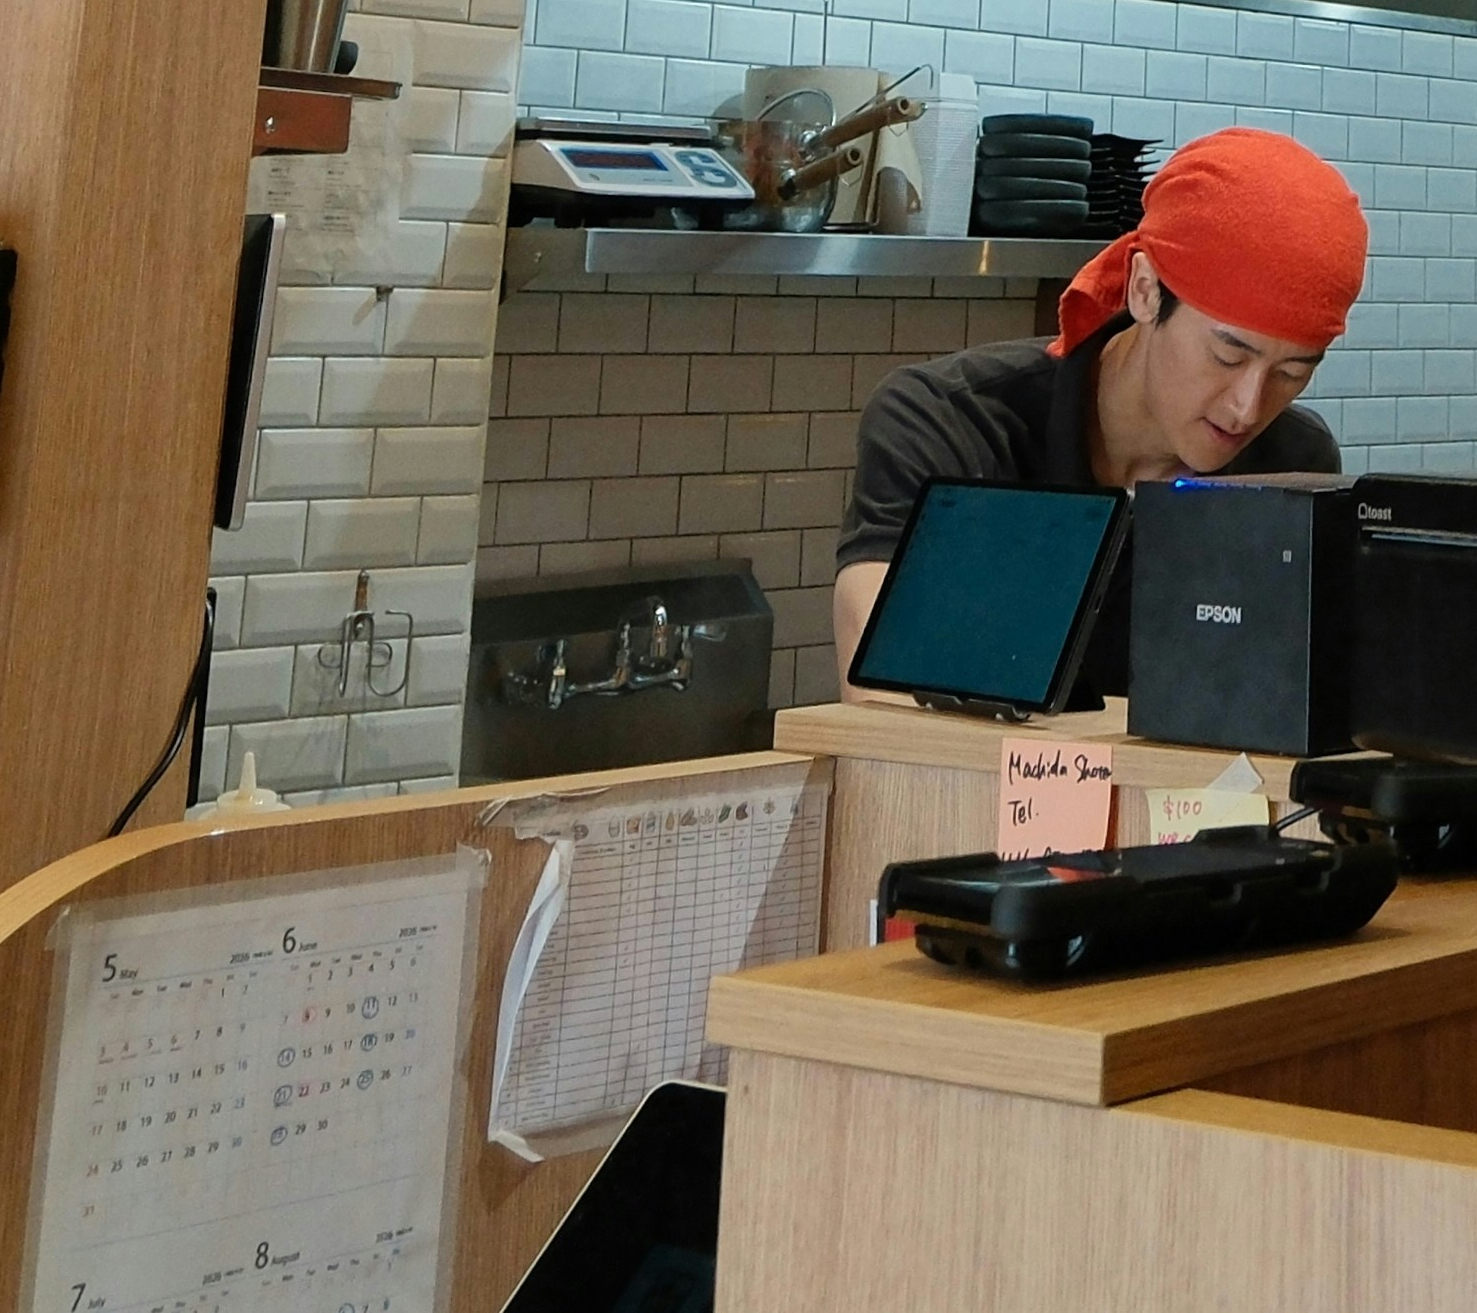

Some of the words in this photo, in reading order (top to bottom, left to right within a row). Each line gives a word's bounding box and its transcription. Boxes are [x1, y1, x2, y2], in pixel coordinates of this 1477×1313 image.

[1367, 506, 1392, 521] toast
[1195, 603, 1242, 624] EPSON
[1162, 795, 1203, 821] $100
[282, 926, 297, 954] 6
[102, 953, 117, 983] 5
[255, 1241, 269, 1269] 8
[71, 1283, 86, 1312] 7
